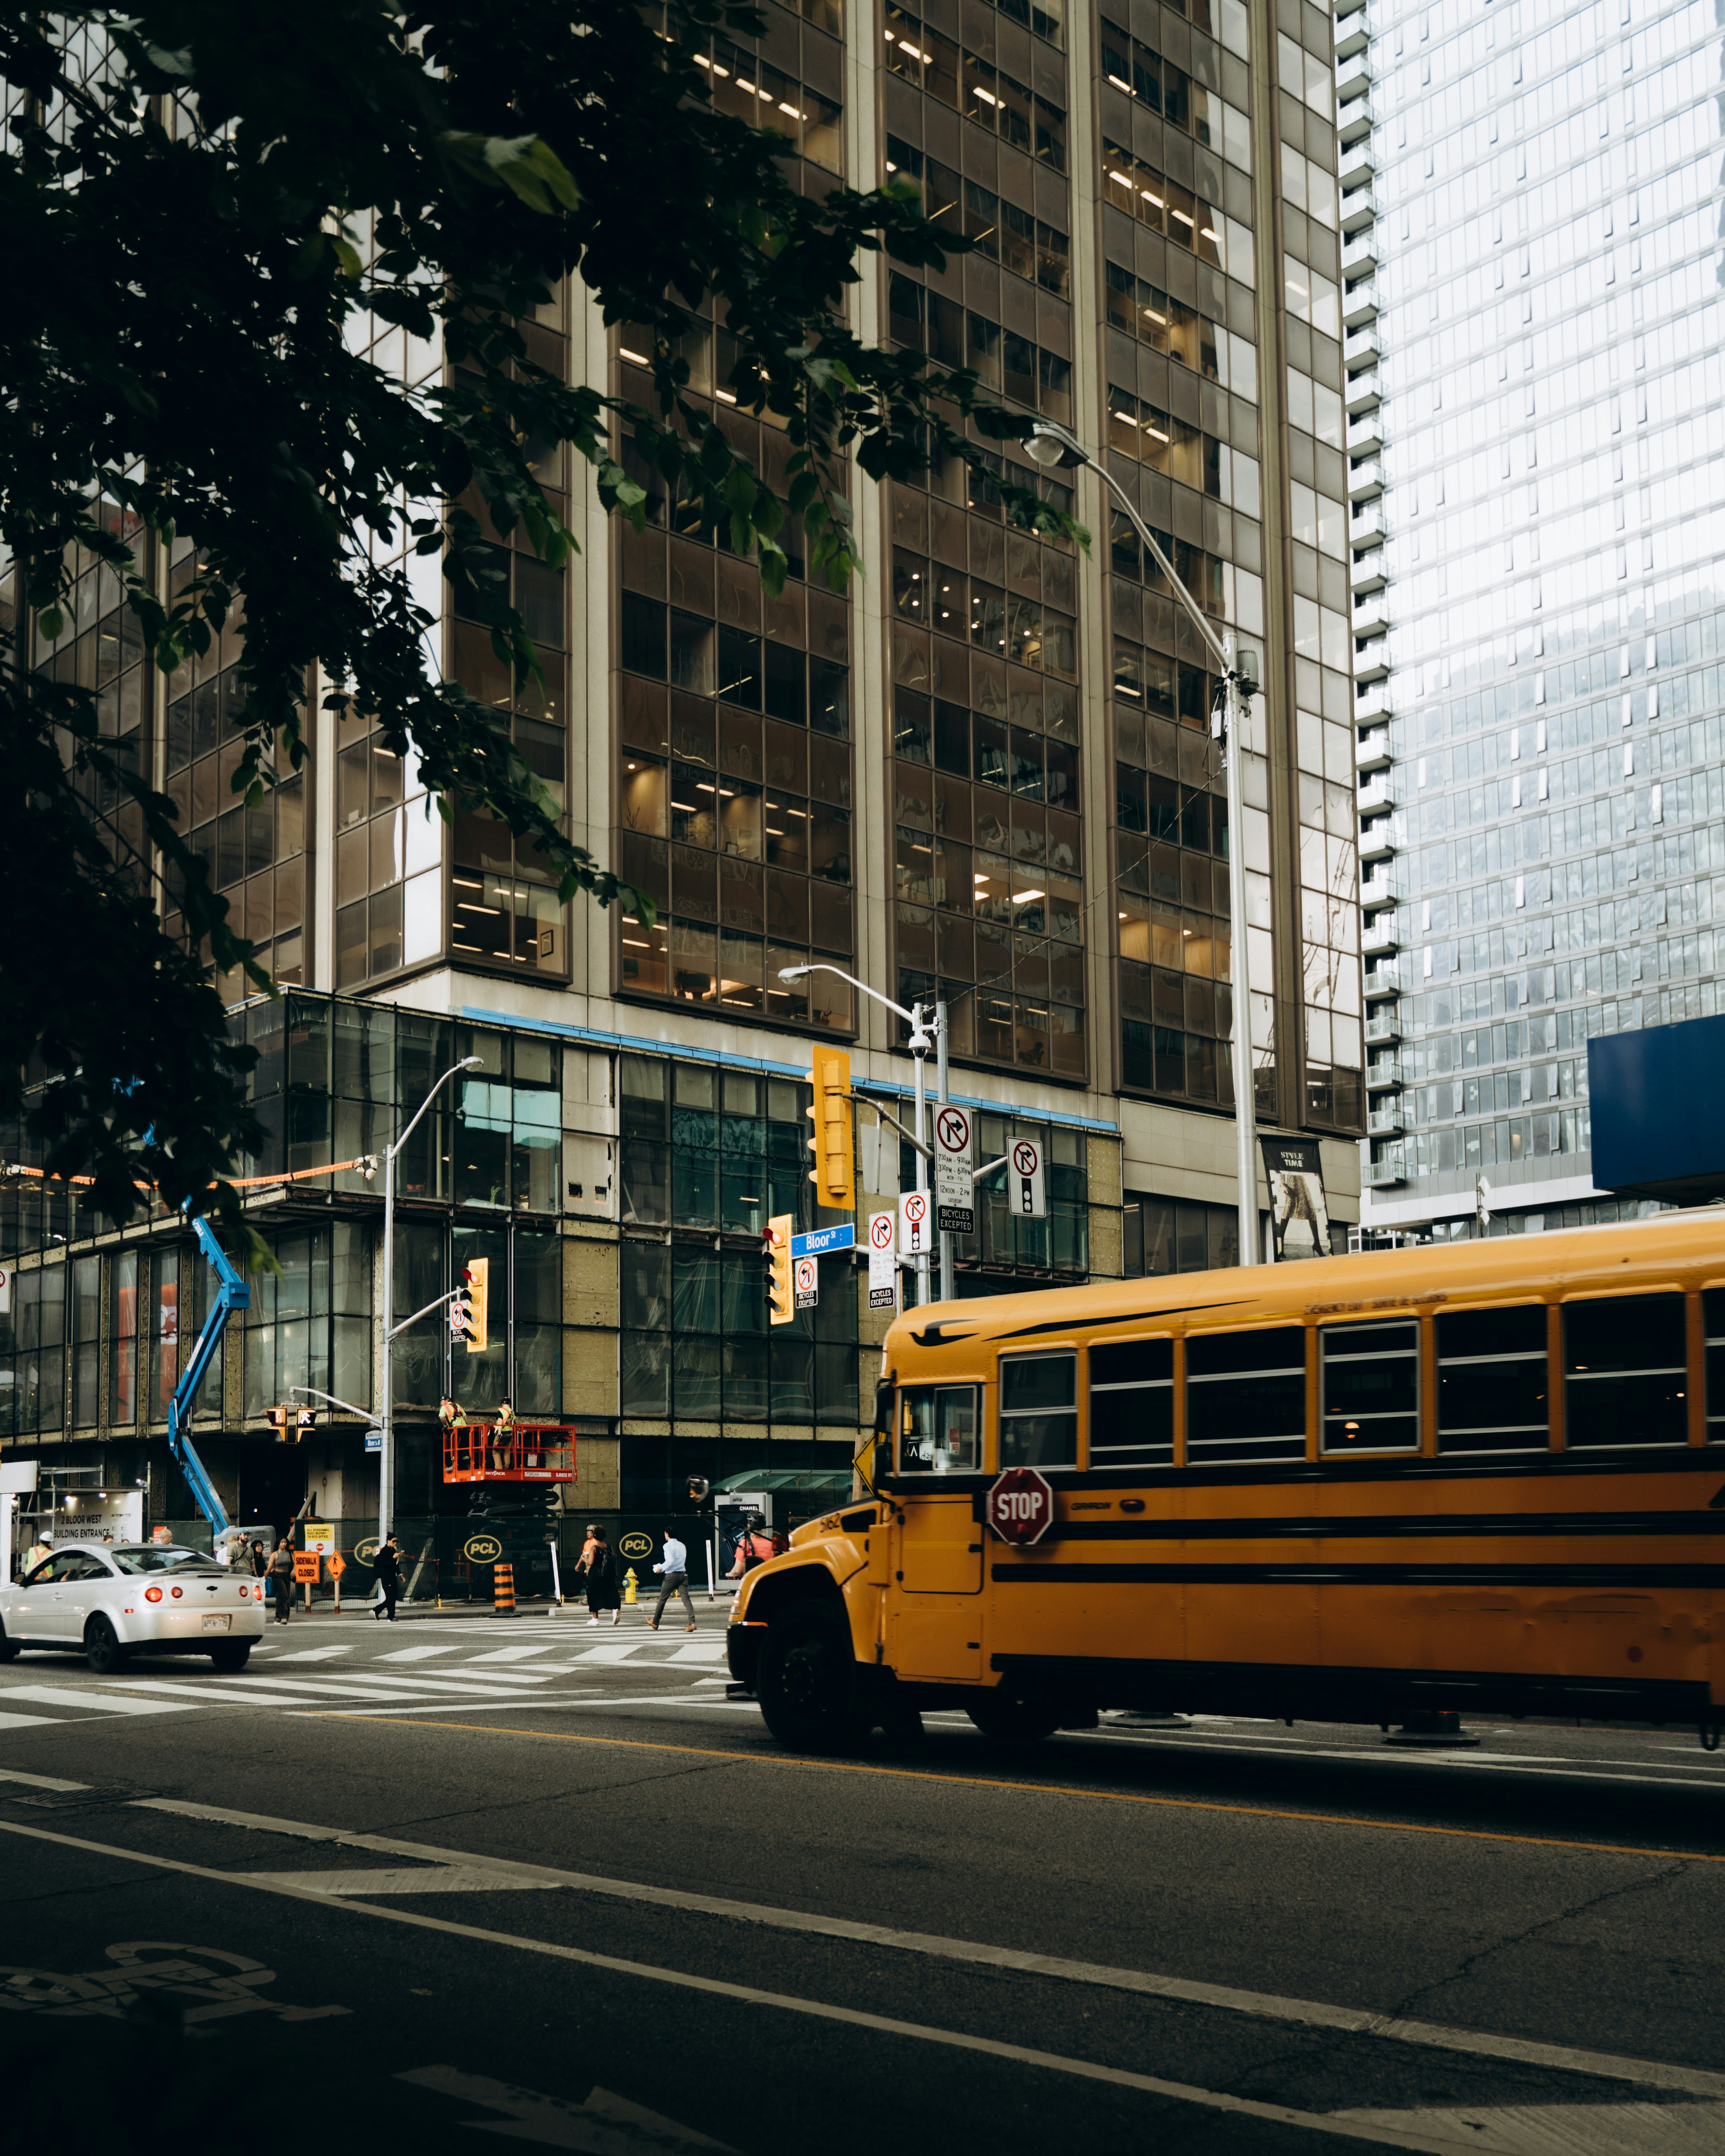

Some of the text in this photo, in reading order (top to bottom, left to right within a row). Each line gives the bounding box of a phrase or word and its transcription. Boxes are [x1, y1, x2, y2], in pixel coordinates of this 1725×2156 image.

[1284, 1159, 1303, 1167] TIME
[942, 1209, 969, 1220] BICYCLES
[941, 1219, 971, 1230] EXCEPTED
[806, 1234, 830, 1250] Bloor
[872, 1289, 891, 1298] BICYCLES
[799, 1299, 814, 1307] EXCEPTED
[871, 1297, 892, 1306] EXCEPTED
[997, 1492, 1043, 1520] STOP
[62, 1516, 65, 1524] 2
[66, 1515, 85, 1524] BLOOR
[86, 1514, 102, 1523] WEST
[54, 1529, 78, 1538] BUILDING
[470, 1543, 496, 1554] PCL
[625, 1540, 647, 1551] PCL
